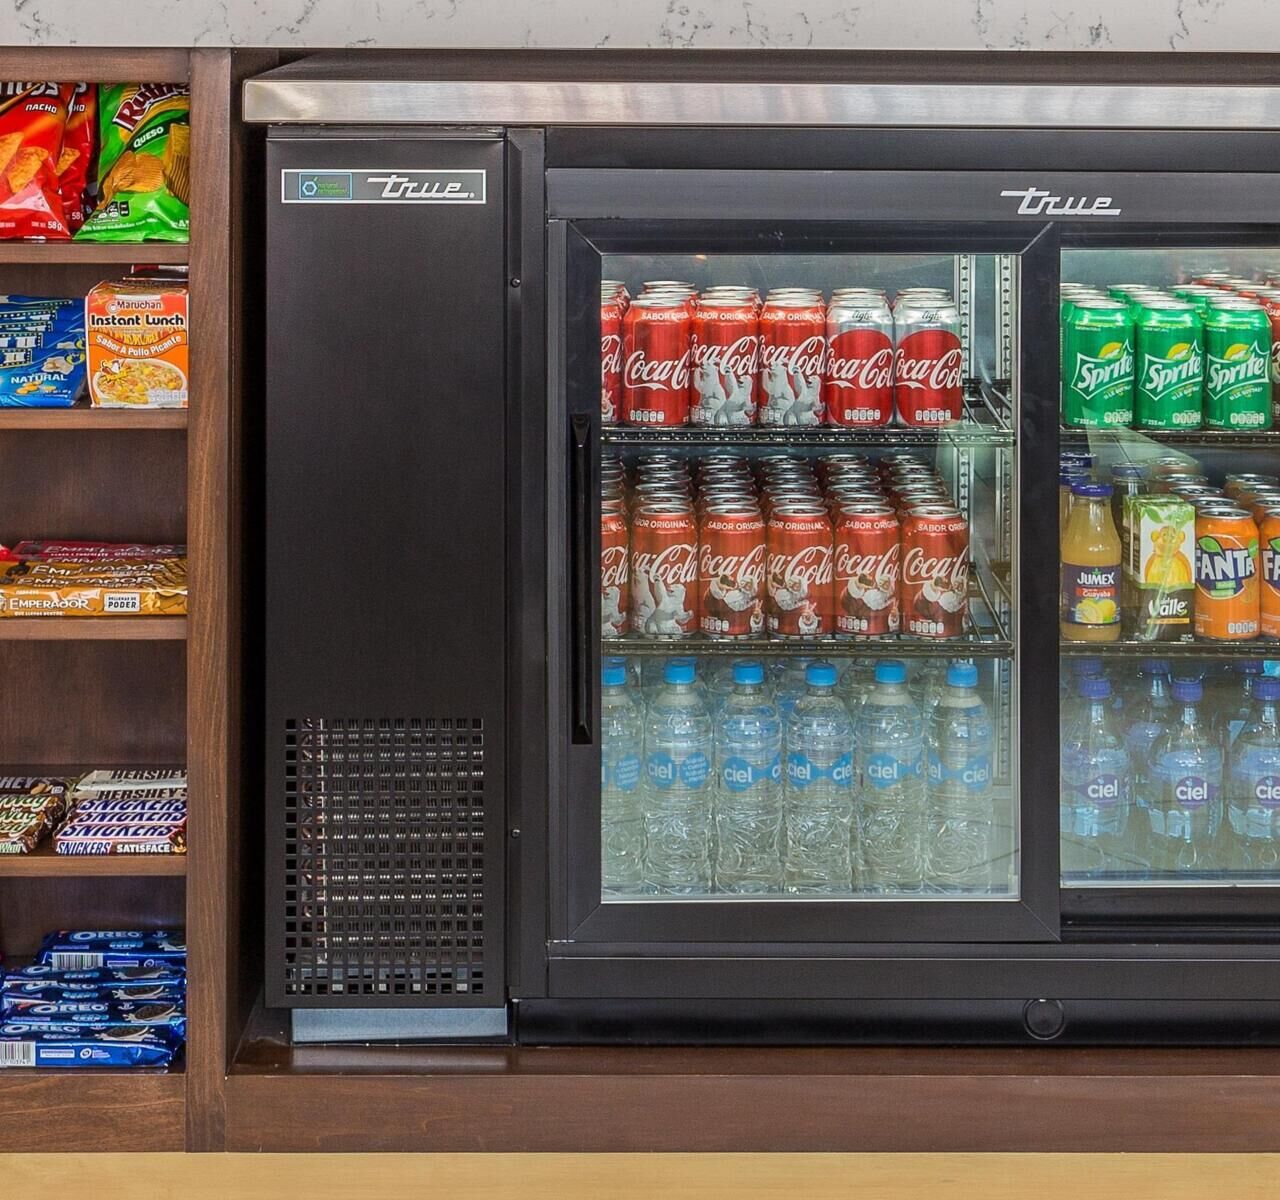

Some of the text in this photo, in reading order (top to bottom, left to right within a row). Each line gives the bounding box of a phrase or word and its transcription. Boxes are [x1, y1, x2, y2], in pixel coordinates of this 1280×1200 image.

[133, 126, 164, 148] QUESO
[117, 300, 162, 310] Maruchan
[91, 314, 184, 326] Instant Lunch
[641, 312, 670, 321] SABOR
[96, 335, 182, 357] Sabor A Pollo Picante
[11, 373, 68, 384] NATURAL
[1077, 352, 1133, 392] Sprite
[1145, 351, 1201, 393] Sprite
[1208, 351, 1265, 393] Sprite
[708, 520, 735, 530] SABOR
[785, 520, 824, 530] ORIGINAL
[845, 520, 871, 529] SABOR
[918, 523, 947, 532] SABOR
[1195, 549, 1255, 581] FANTA
[1077, 572, 1115, 585] JUMEX
[1082, 589, 1111, 599] Guayaba
[10, 598, 137, 610] EMPERADOR PODER
[648, 761, 673, 779] ciel
[724, 764, 753, 783] ciel
[788, 761, 811, 780] ciel
[868, 762, 898, 780] ciel
[962, 764, 990, 783] ciel
[1087, 779, 1118, 799] ciel
[1176, 781, 1207, 801] ciel
[58, 841, 170, 855] SNICKERS SATISFACE
[74, 932, 142, 942] OREO
[33, 1004, 107, 1014] OREO
